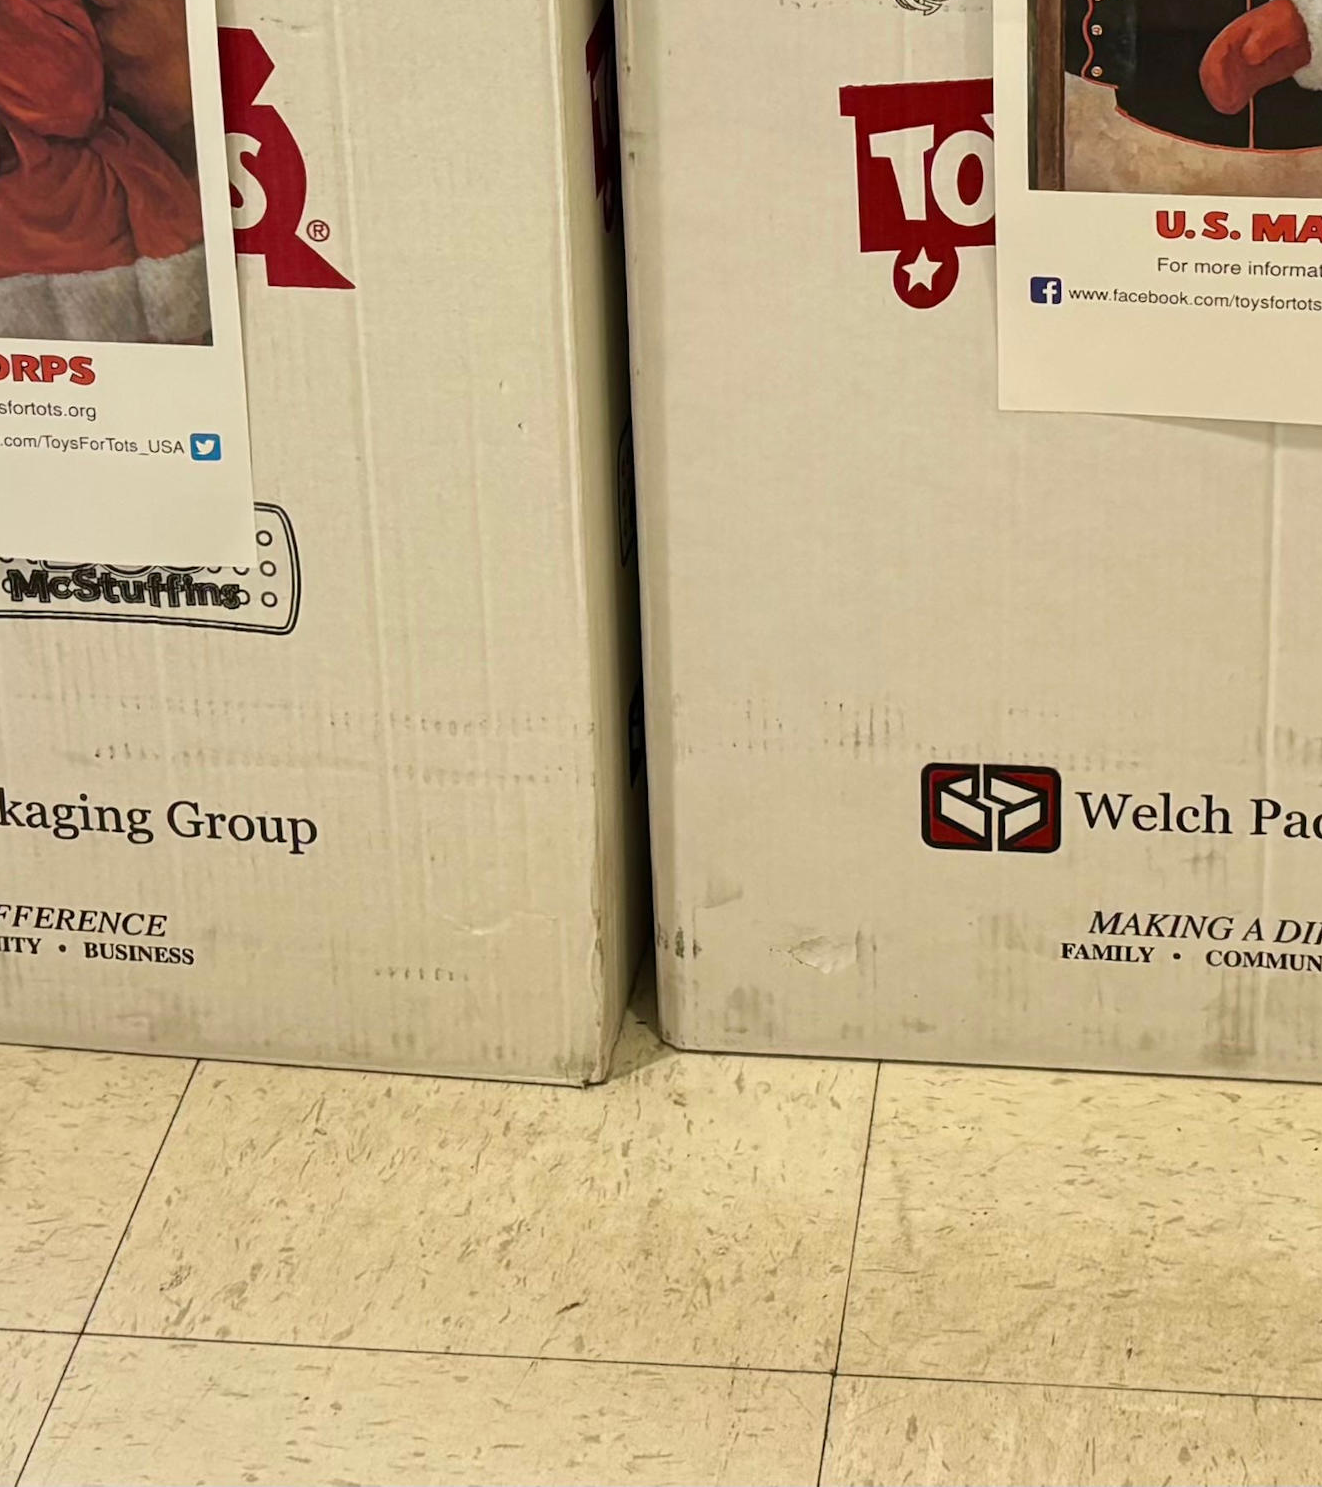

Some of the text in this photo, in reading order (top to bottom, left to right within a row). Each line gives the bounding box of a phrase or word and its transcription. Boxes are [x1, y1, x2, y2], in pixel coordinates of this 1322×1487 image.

[1156, 211, 1241, 240] U.S.
[1158, 258, 1188, 272] For
[1195, 263, 1241, 275] more
[1069, 289, 1322, 311] www.facebook.com/toysfortots
[5, 568, 242, 611] McStuffins
[167, 801, 317, 854] Group
[1075, 792, 1232, 834] Welch
[1089, 911, 1233, 940] MAKING
[1242, 918, 1264, 941] A
[84, 942, 194, 965] BUSINESS
[1062, 943, 1154, 963] FAMILY
